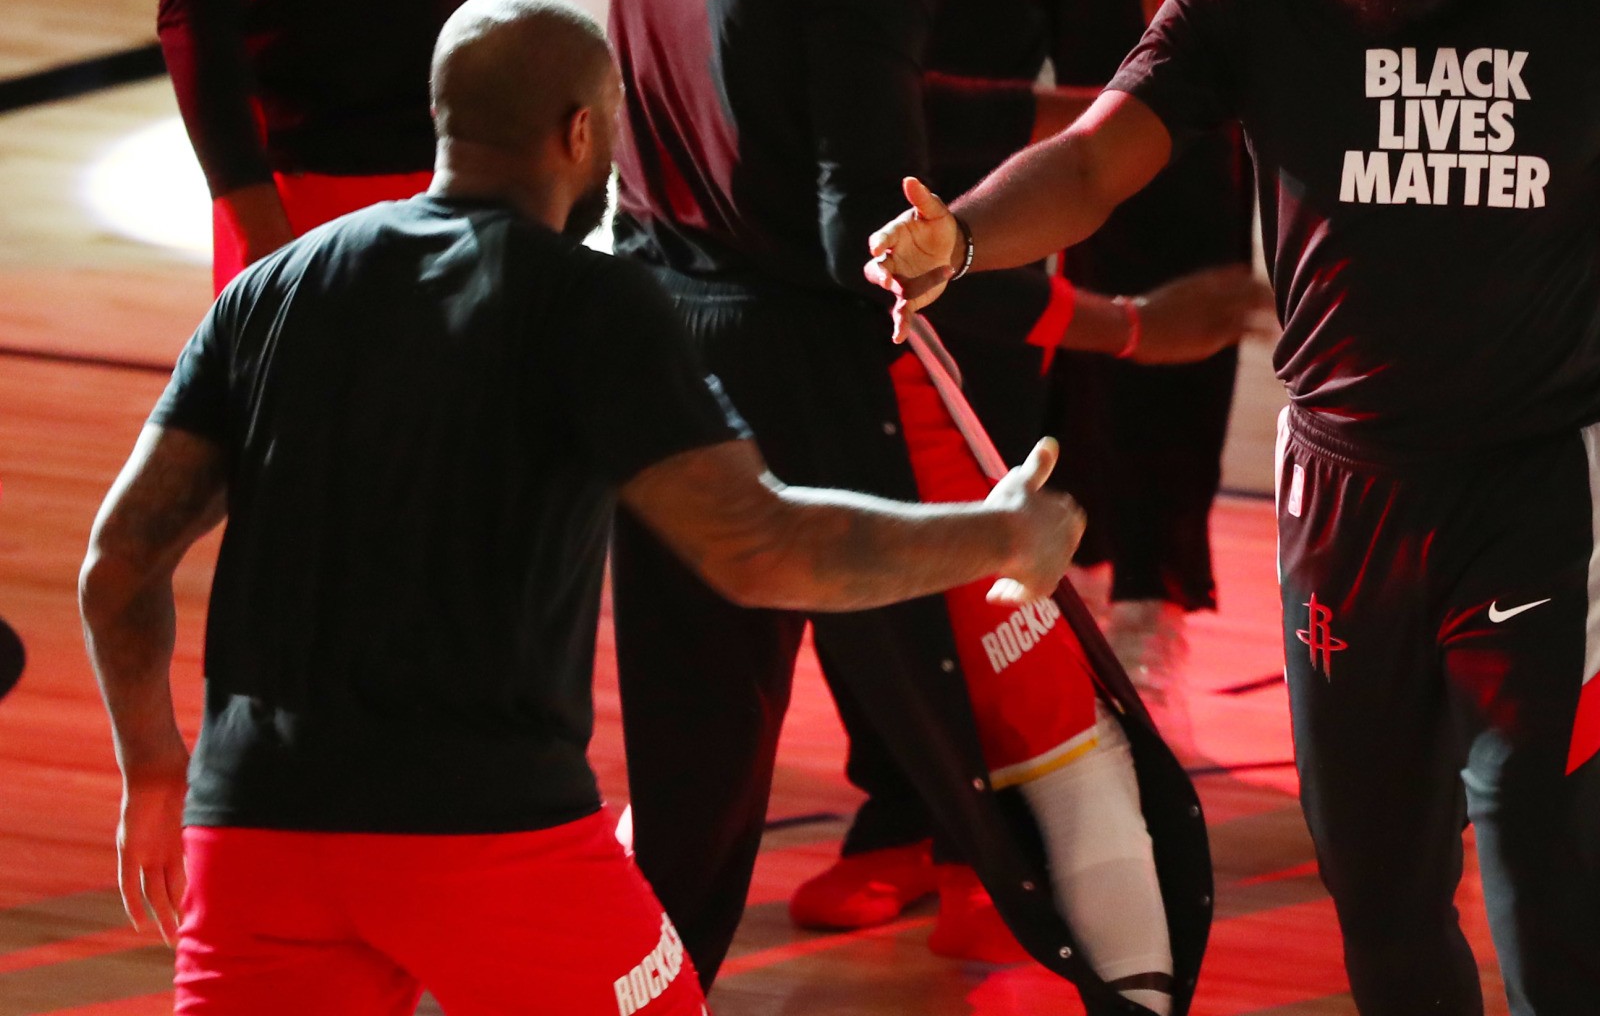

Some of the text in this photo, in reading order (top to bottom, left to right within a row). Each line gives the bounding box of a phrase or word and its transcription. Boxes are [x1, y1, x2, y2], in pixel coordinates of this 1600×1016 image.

[1365, 47, 1531, 101] BLACK
[1378, 99, 1515, 153] LIVES
[1339, 150, 1551, 209] MATTER
